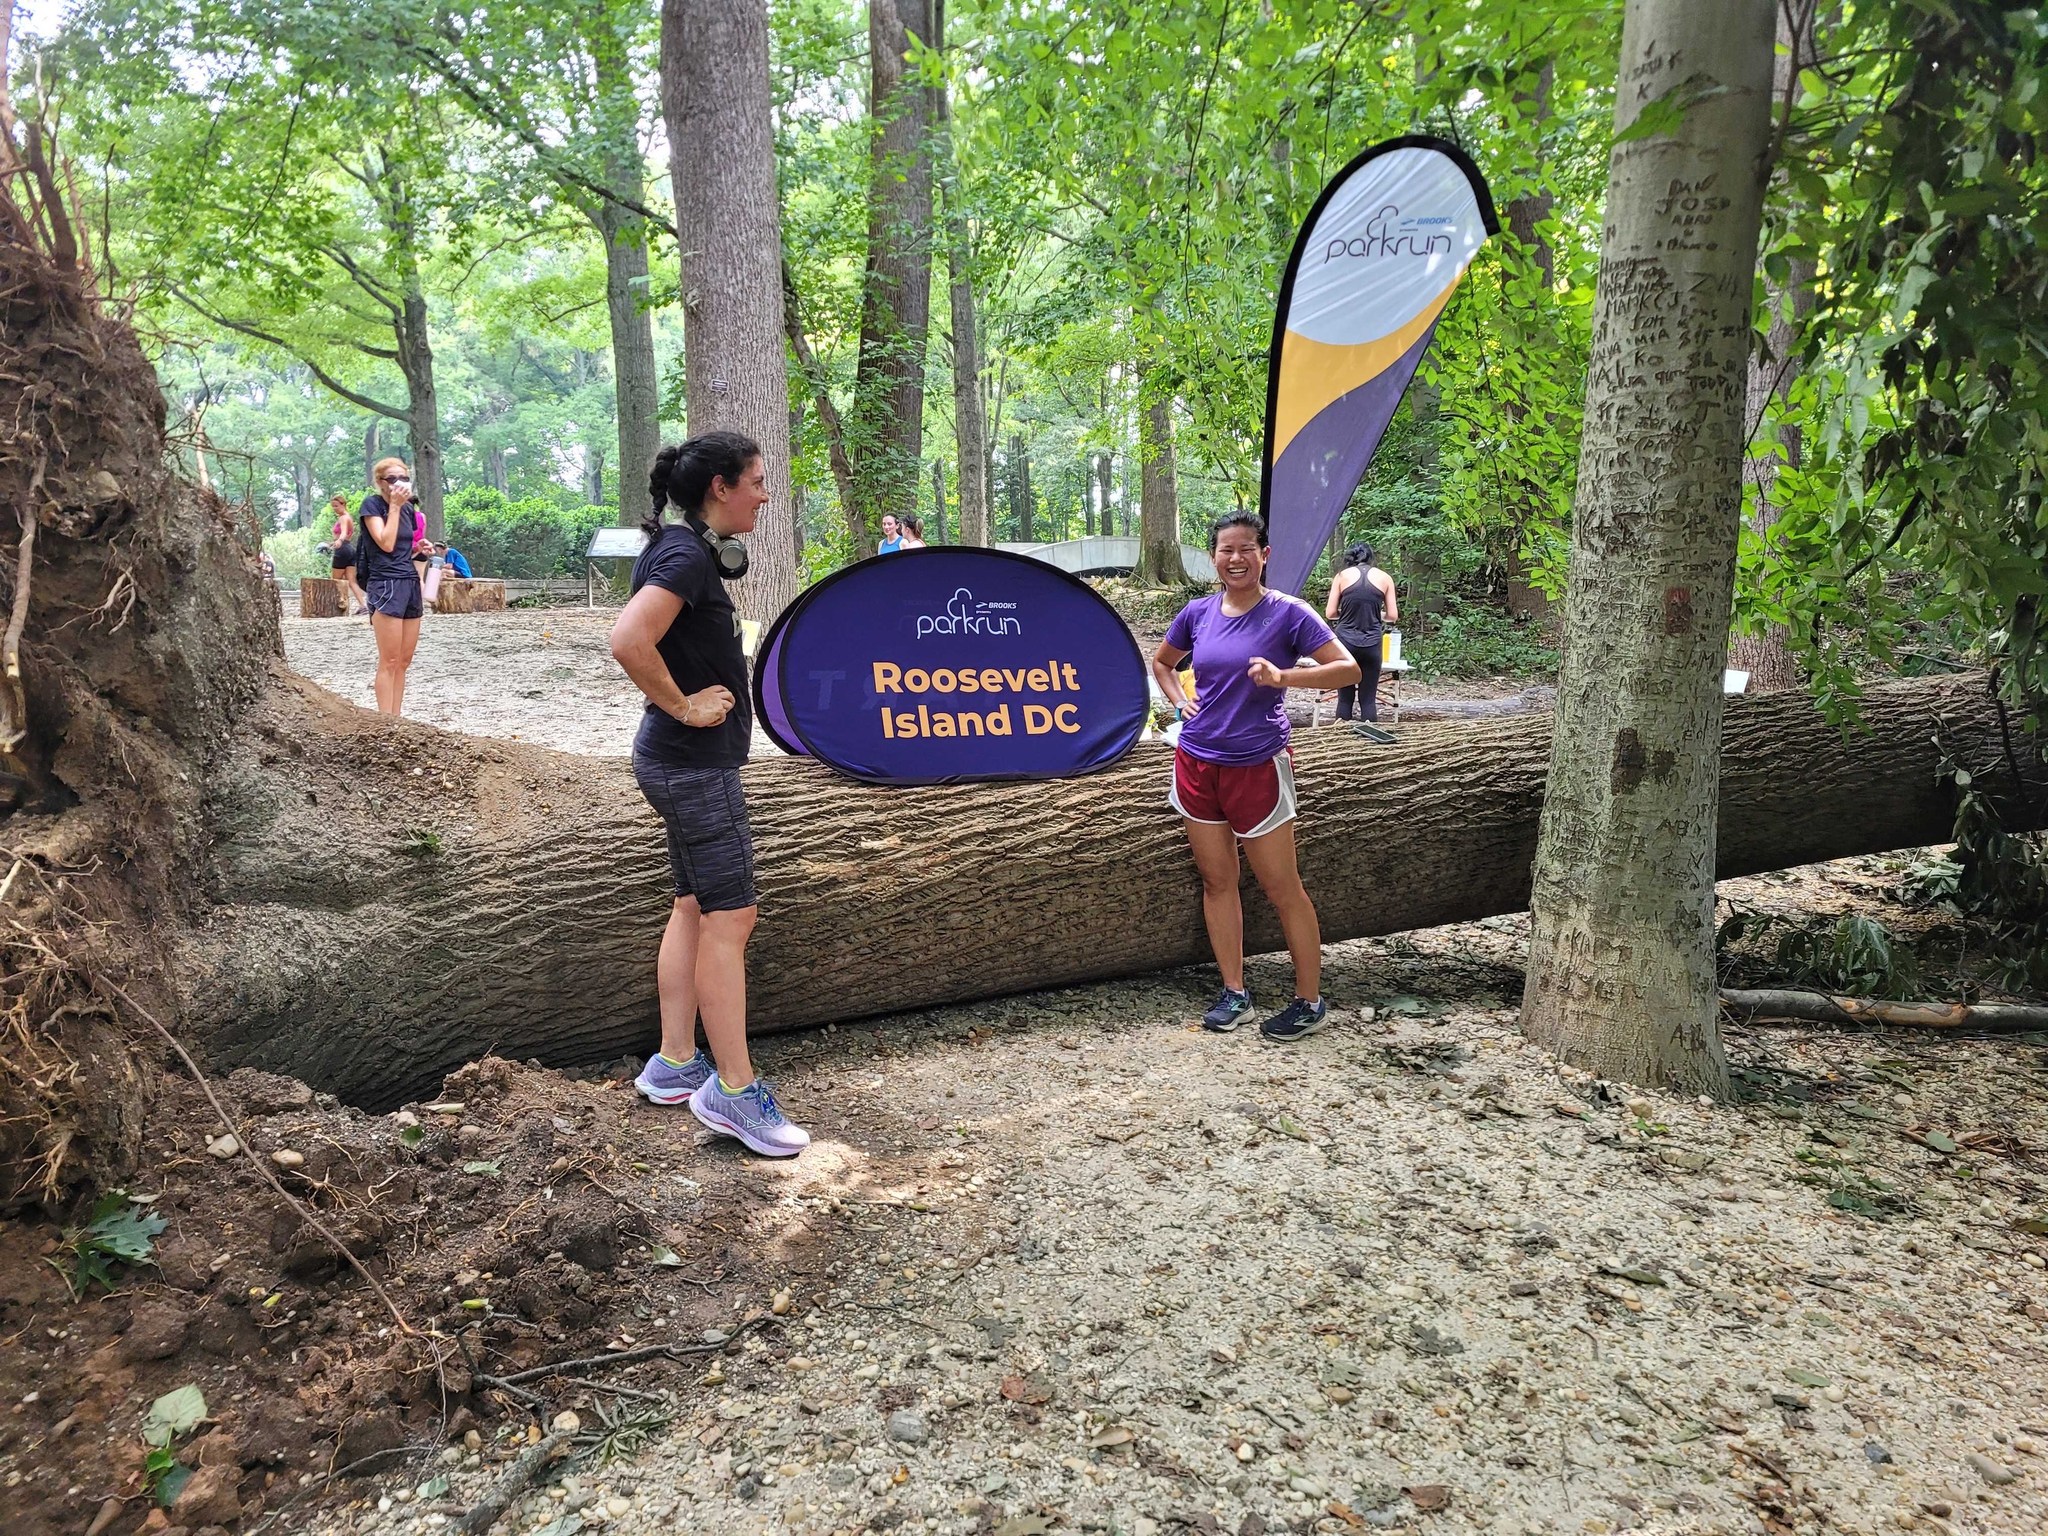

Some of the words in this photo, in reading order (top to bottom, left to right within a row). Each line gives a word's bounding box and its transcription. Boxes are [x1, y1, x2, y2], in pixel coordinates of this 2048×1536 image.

[1417, 217, 1453, 225] BROOKS
[1324, 217, 1452, 264] parkrun
[916, 600, 1021, 639] parkrun
[988, 601, 1018, 610] BROOKS
[872, 660, 1081, 694] Roosevelt
[880, 704, 1012, 739] Island
[1023, 703, 1081, 735] DC
